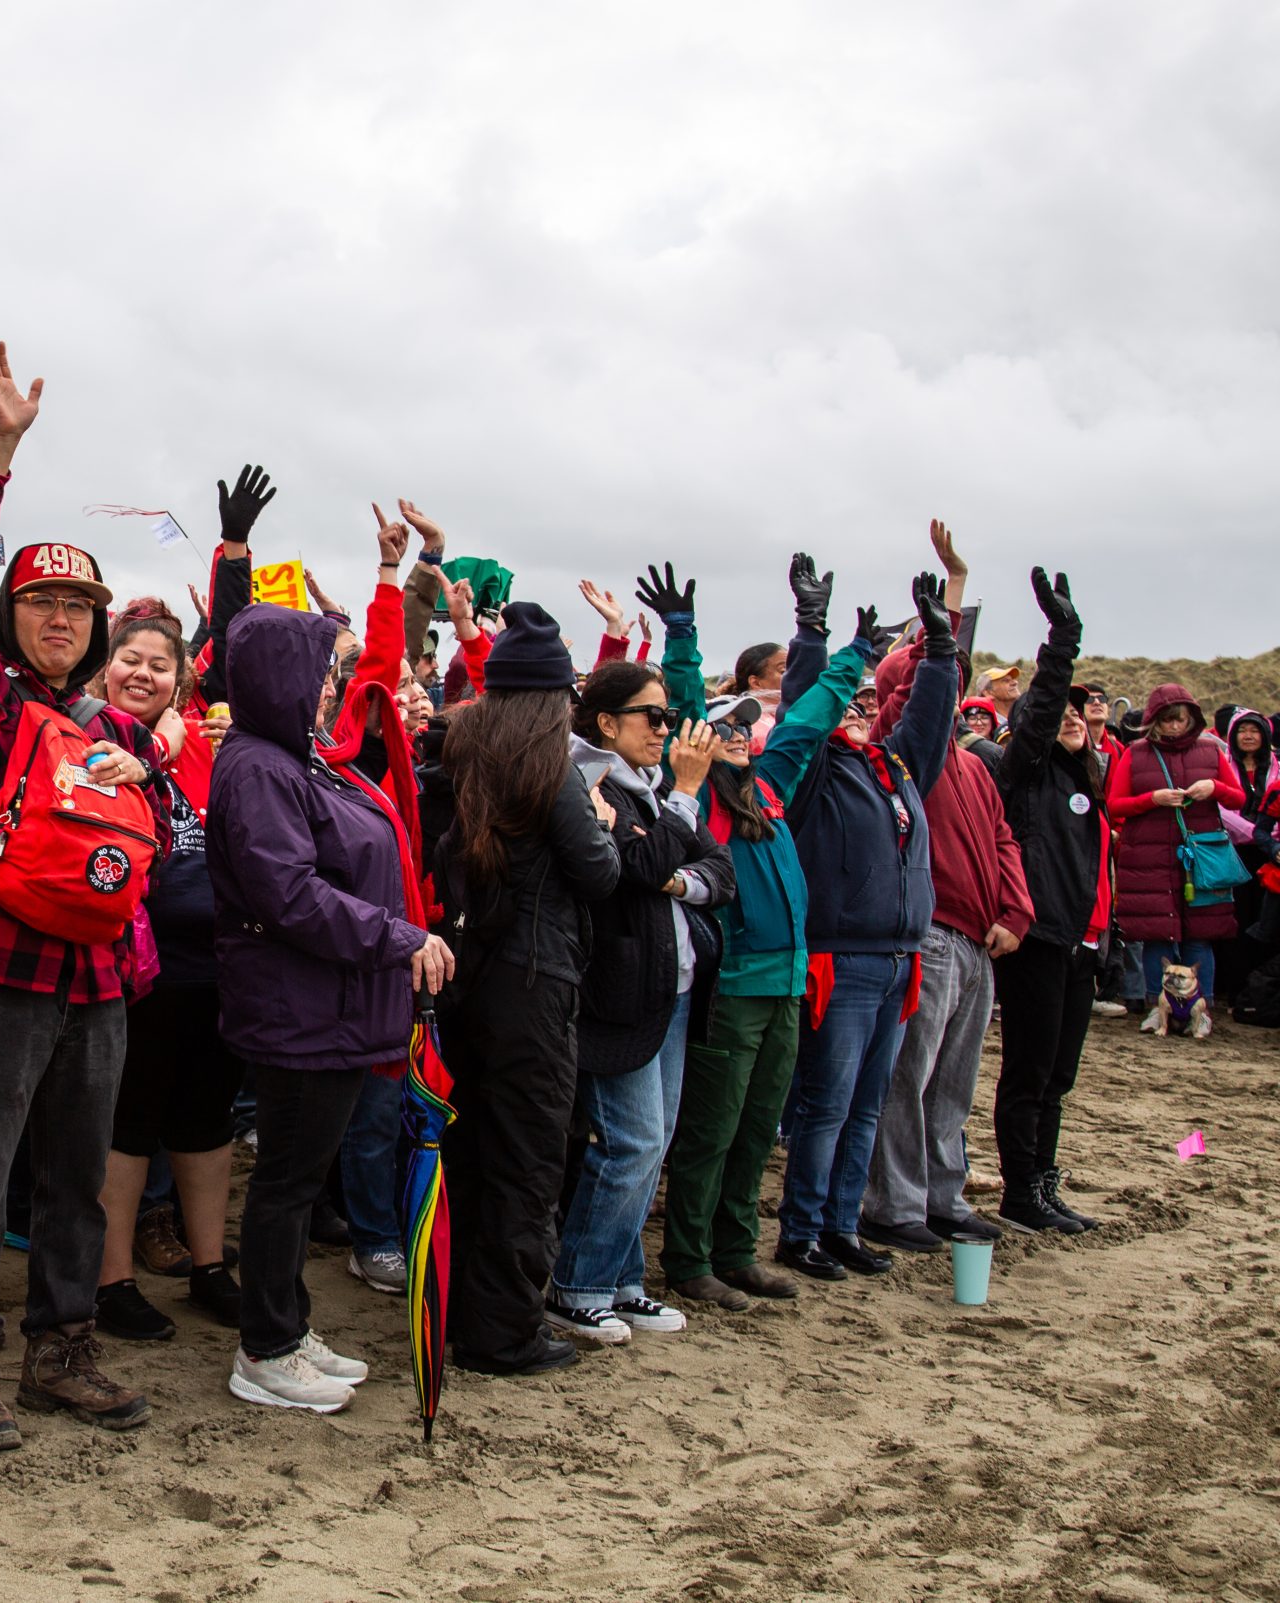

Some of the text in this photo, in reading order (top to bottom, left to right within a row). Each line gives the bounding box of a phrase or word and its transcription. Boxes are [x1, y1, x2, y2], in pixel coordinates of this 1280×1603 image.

[33, 545, 94, 581] 49ERS
[178, 829, 205, 840] EDUCA
[178, 838, 205, 846] FRANC
[98, 848, 129, 869] NO JUSTICE
[90, 874, 104, 888] JUST
